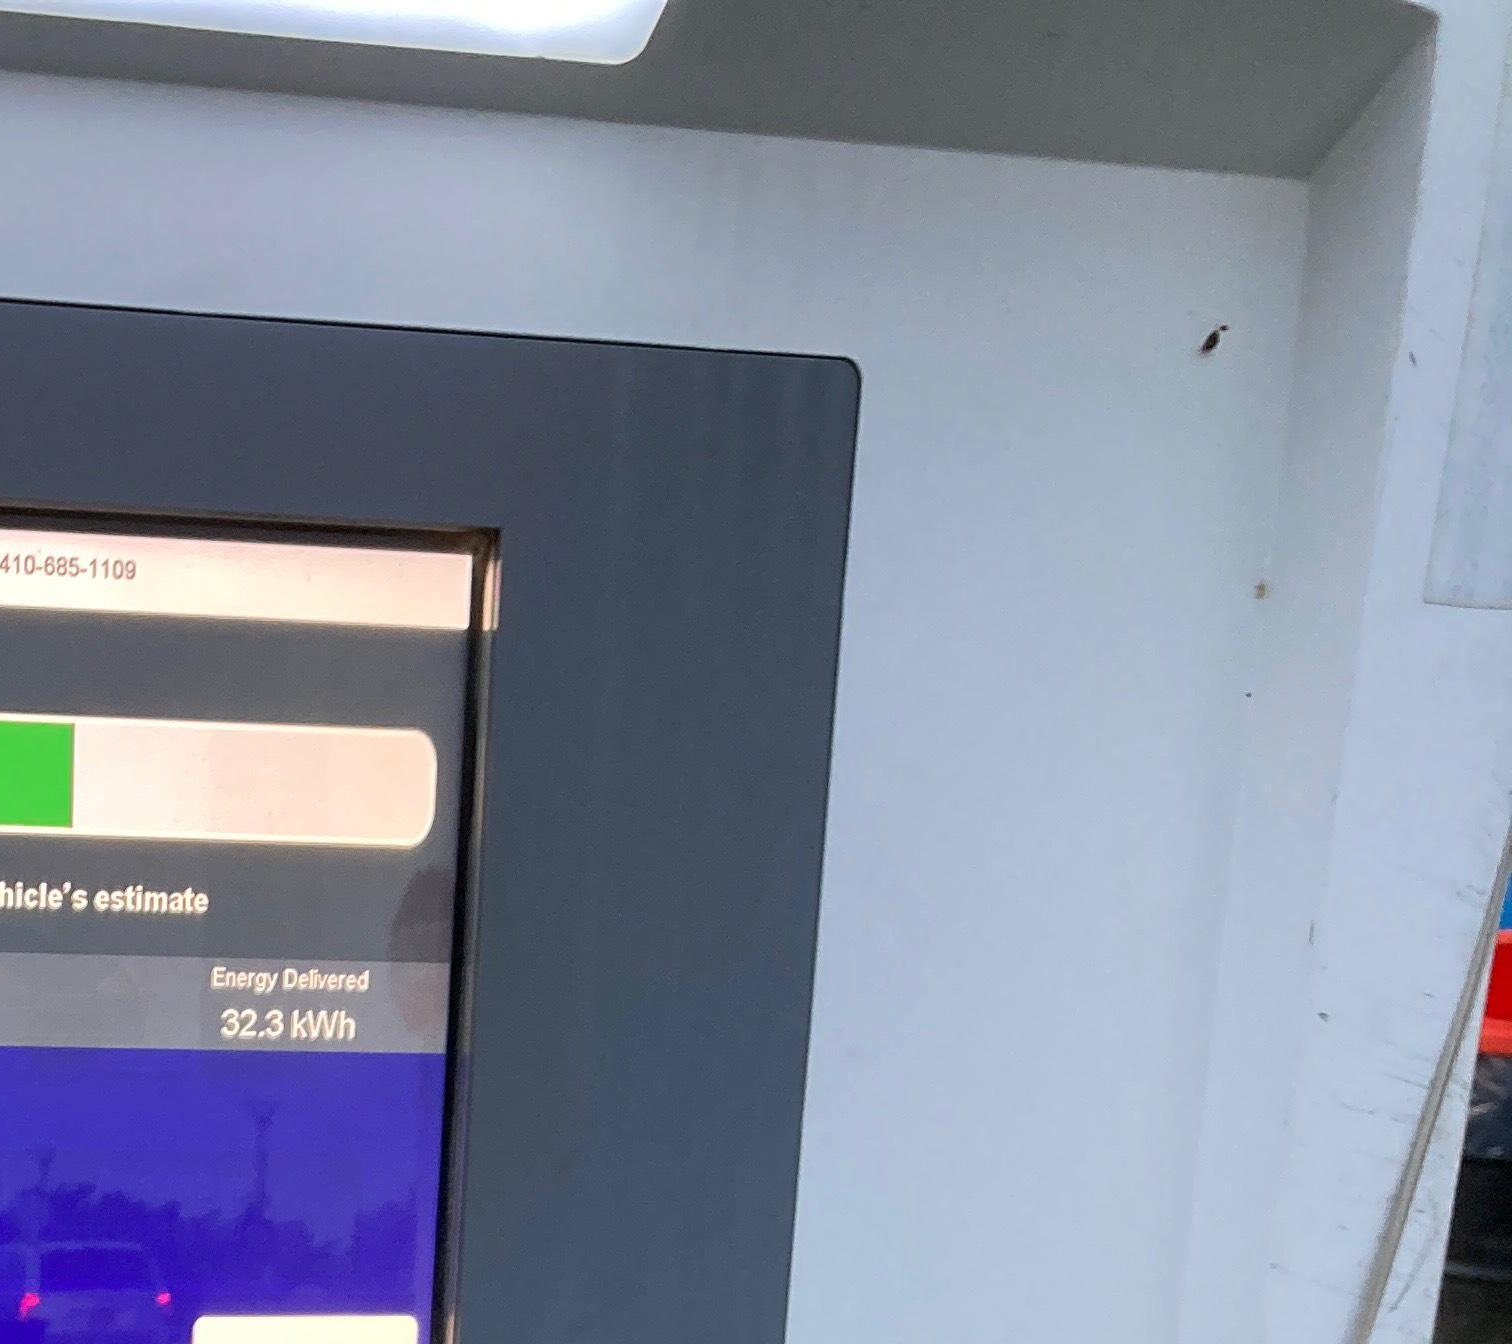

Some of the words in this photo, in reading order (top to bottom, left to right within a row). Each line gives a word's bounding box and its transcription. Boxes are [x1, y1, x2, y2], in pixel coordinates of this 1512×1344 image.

[94, 887, 209, 914] estimate
[210, 966, 277, 993] Energy
[283, 968, 370, 992] Delivered
[219, 1008, 285, 1039] 32.3
[290, 1009, 356, 1040] kWh
